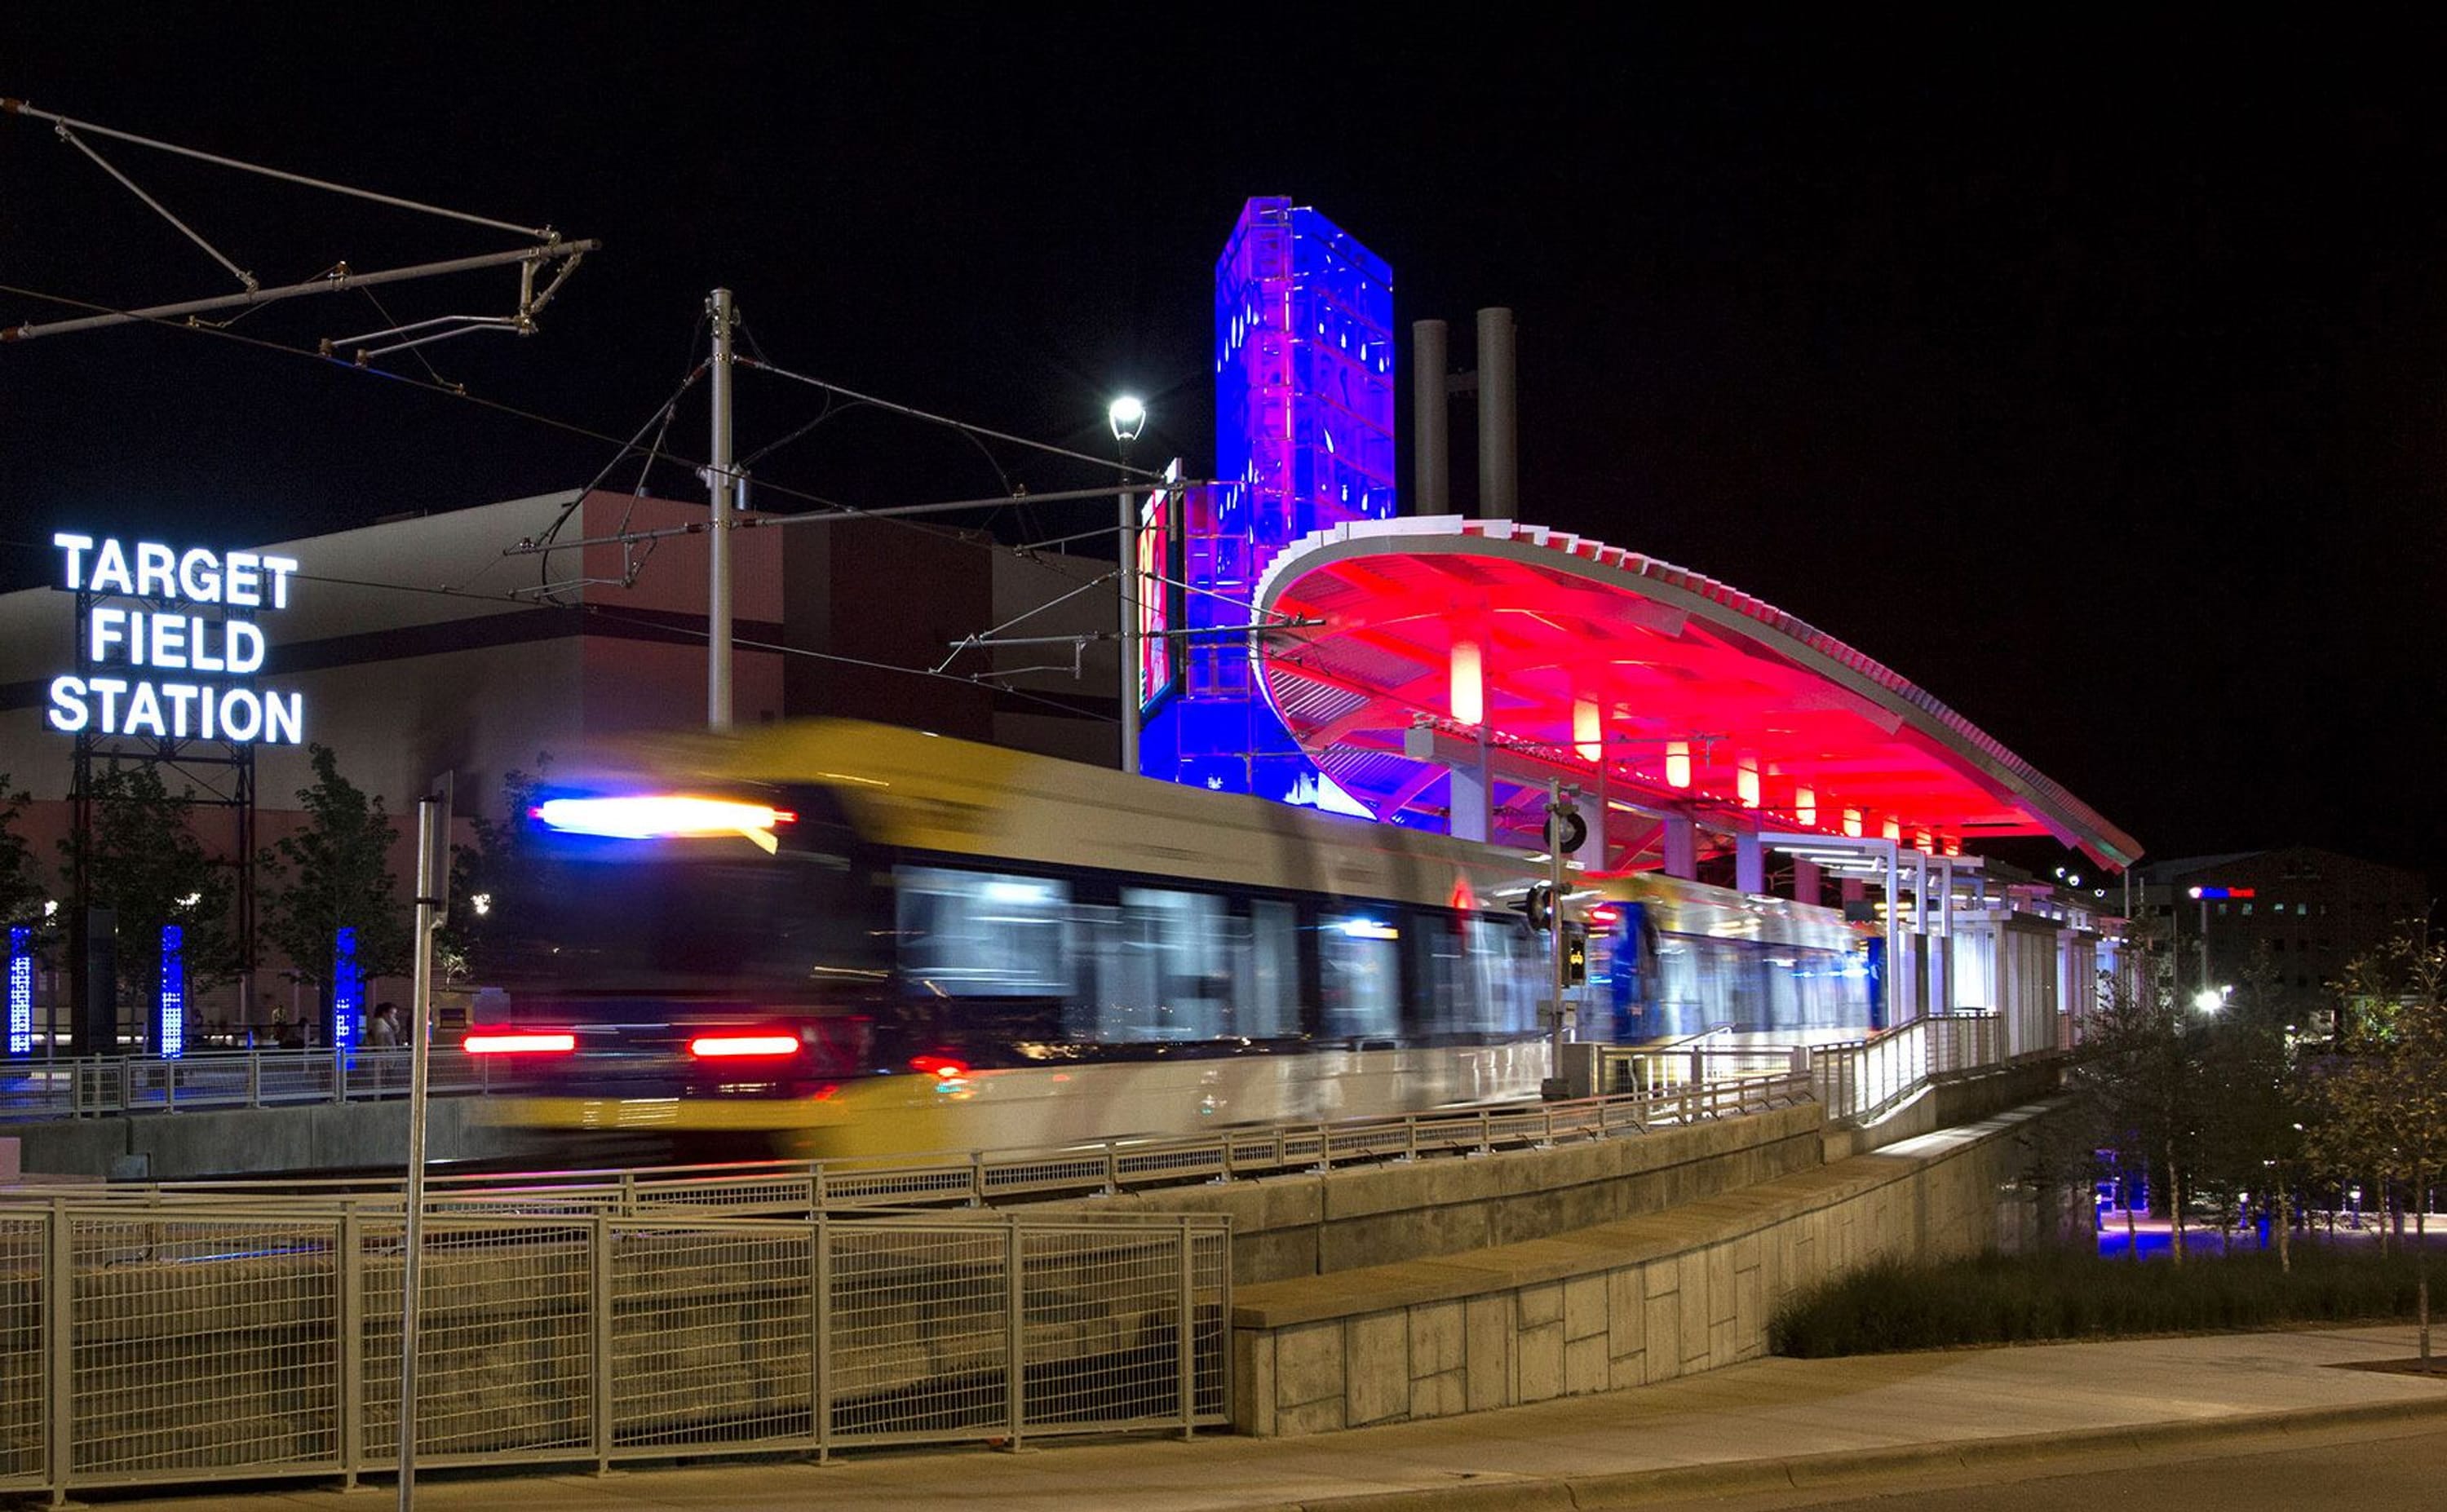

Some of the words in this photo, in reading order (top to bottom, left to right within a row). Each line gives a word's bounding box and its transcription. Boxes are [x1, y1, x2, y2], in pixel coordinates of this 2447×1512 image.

[55, 533, 298, 608] TARGET
[92, 608, 264, 673] FIELD
[50, 676, 302, 744] STATION
